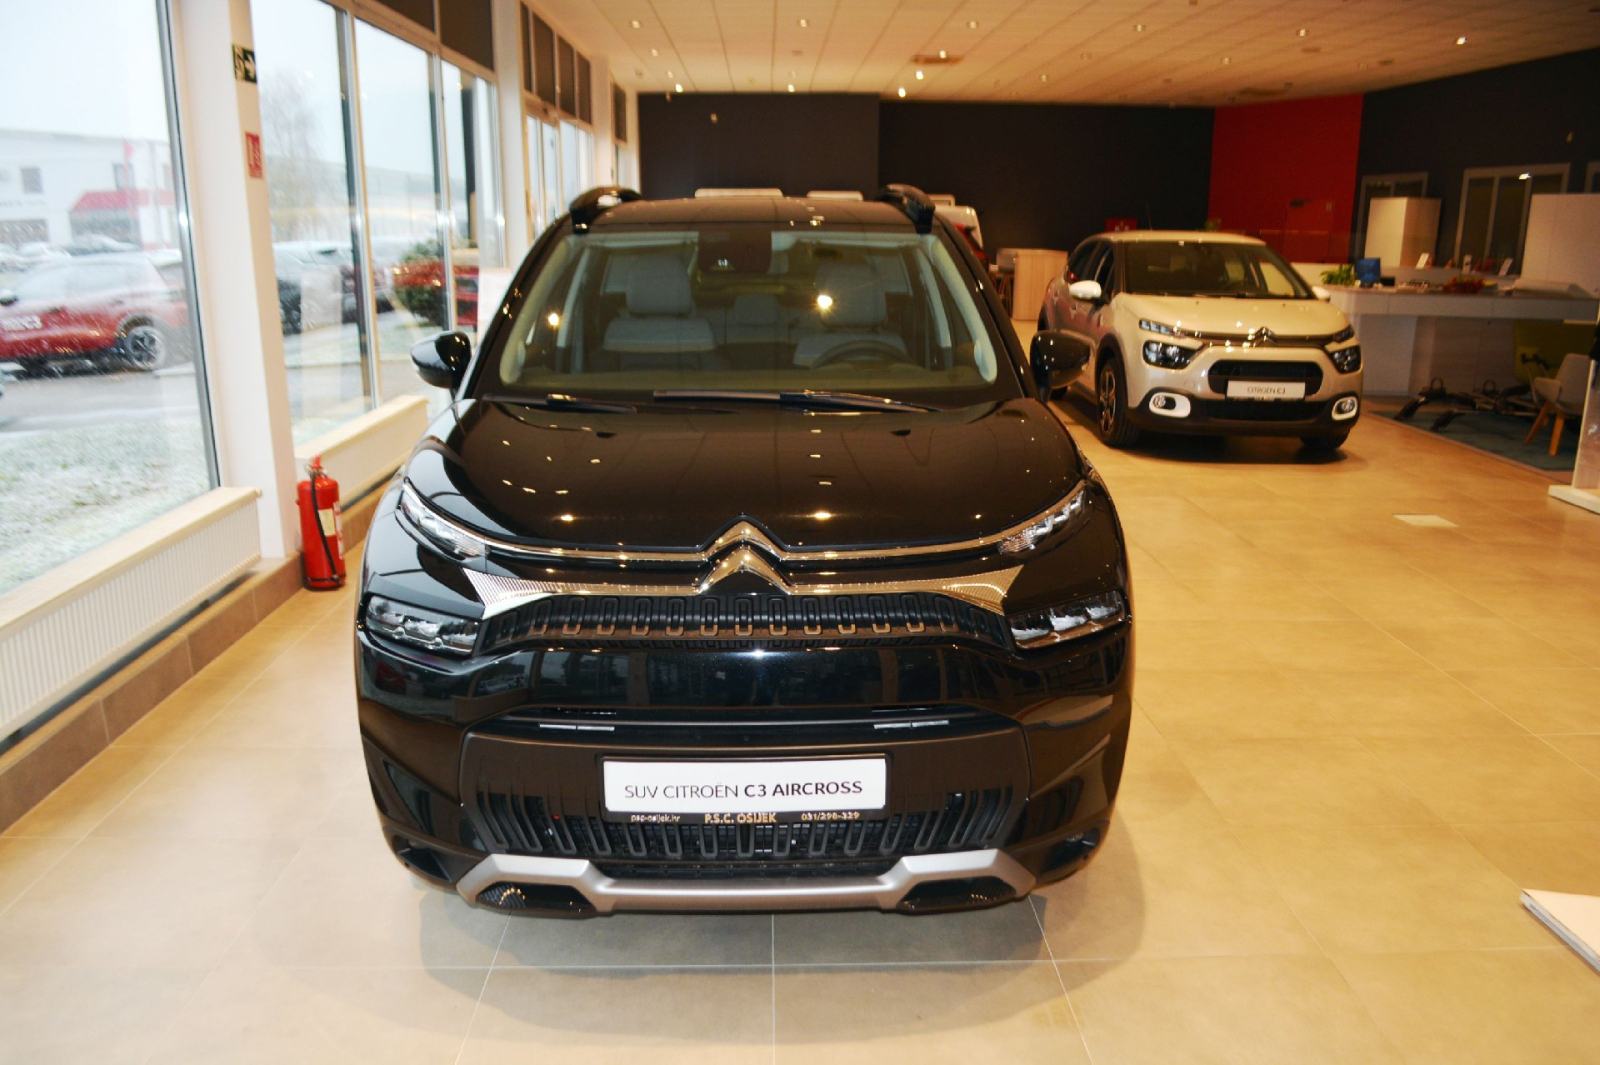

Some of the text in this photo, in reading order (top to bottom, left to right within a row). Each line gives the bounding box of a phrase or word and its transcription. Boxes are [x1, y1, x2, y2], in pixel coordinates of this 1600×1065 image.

[624, 780, 863, 799] SUV CITROËN C3 AIRCROSS
[704, 812, 777, 824] P.S.C. OSIJEK
